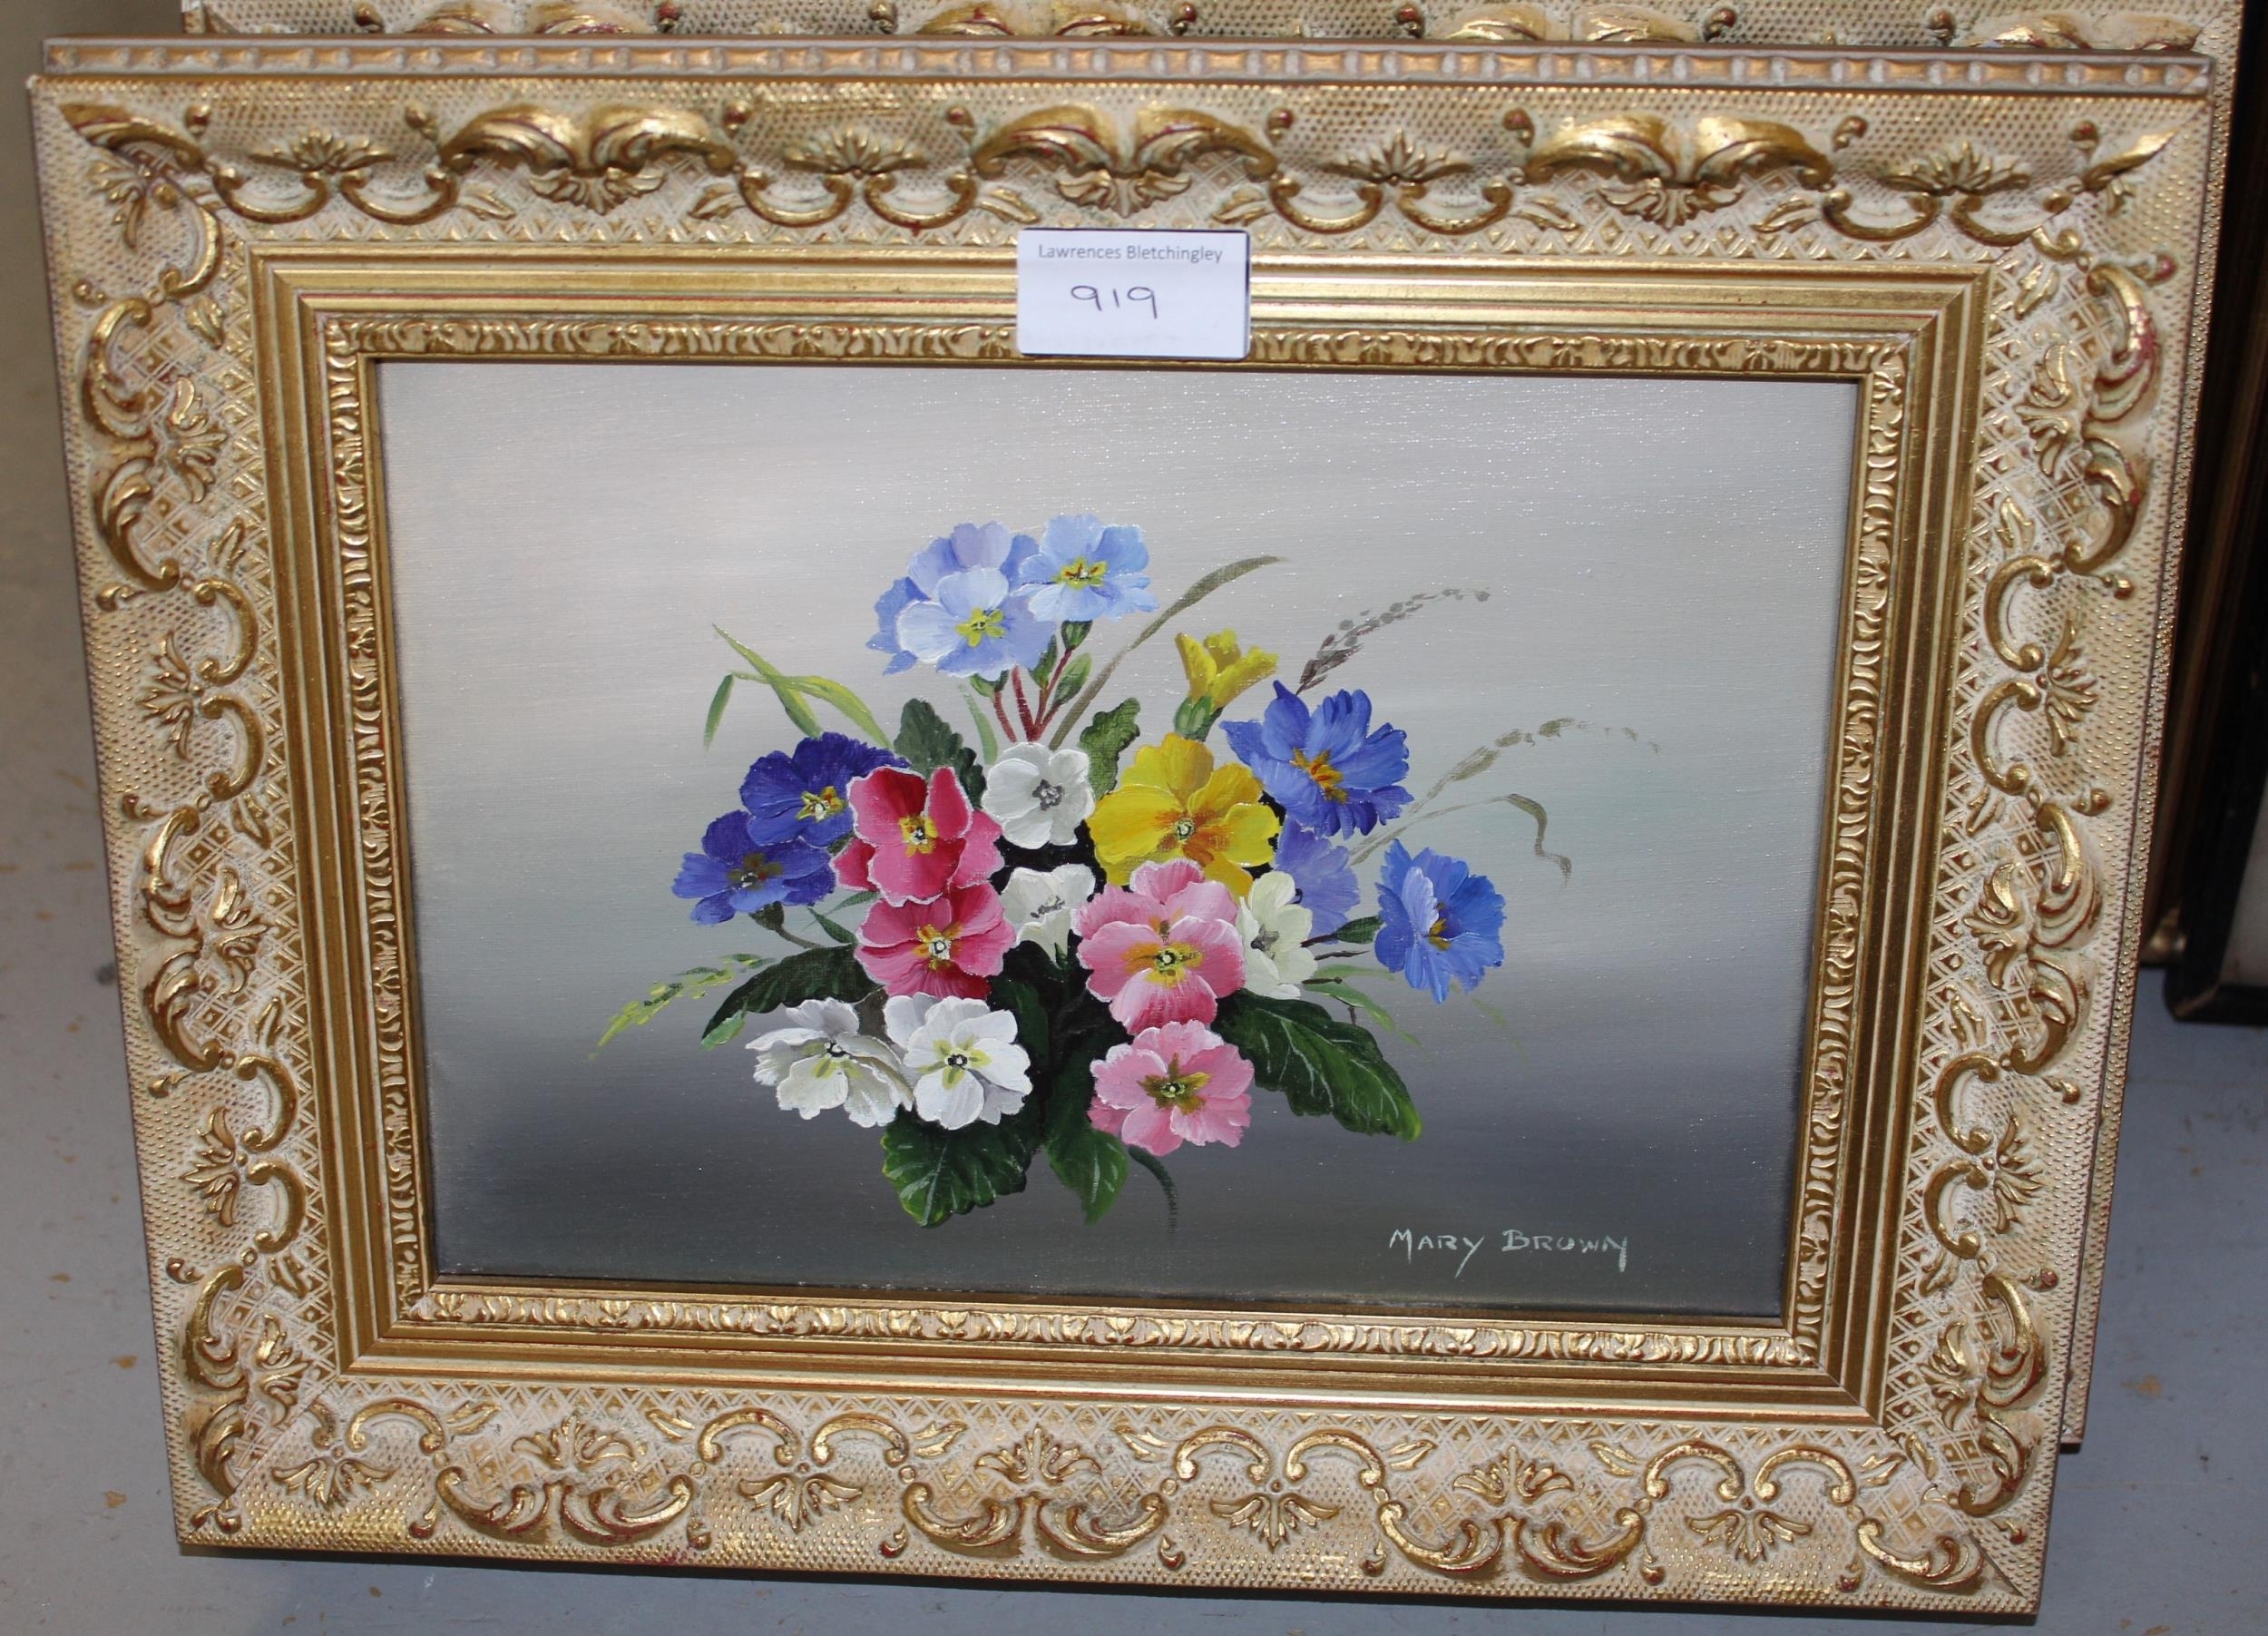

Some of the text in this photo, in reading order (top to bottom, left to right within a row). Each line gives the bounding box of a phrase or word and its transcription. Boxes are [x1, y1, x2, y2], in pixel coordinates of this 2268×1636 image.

[1038, 244, 1223, 263] Lawrences Bletchingley
[1070, 285, 1158, 319] 919
